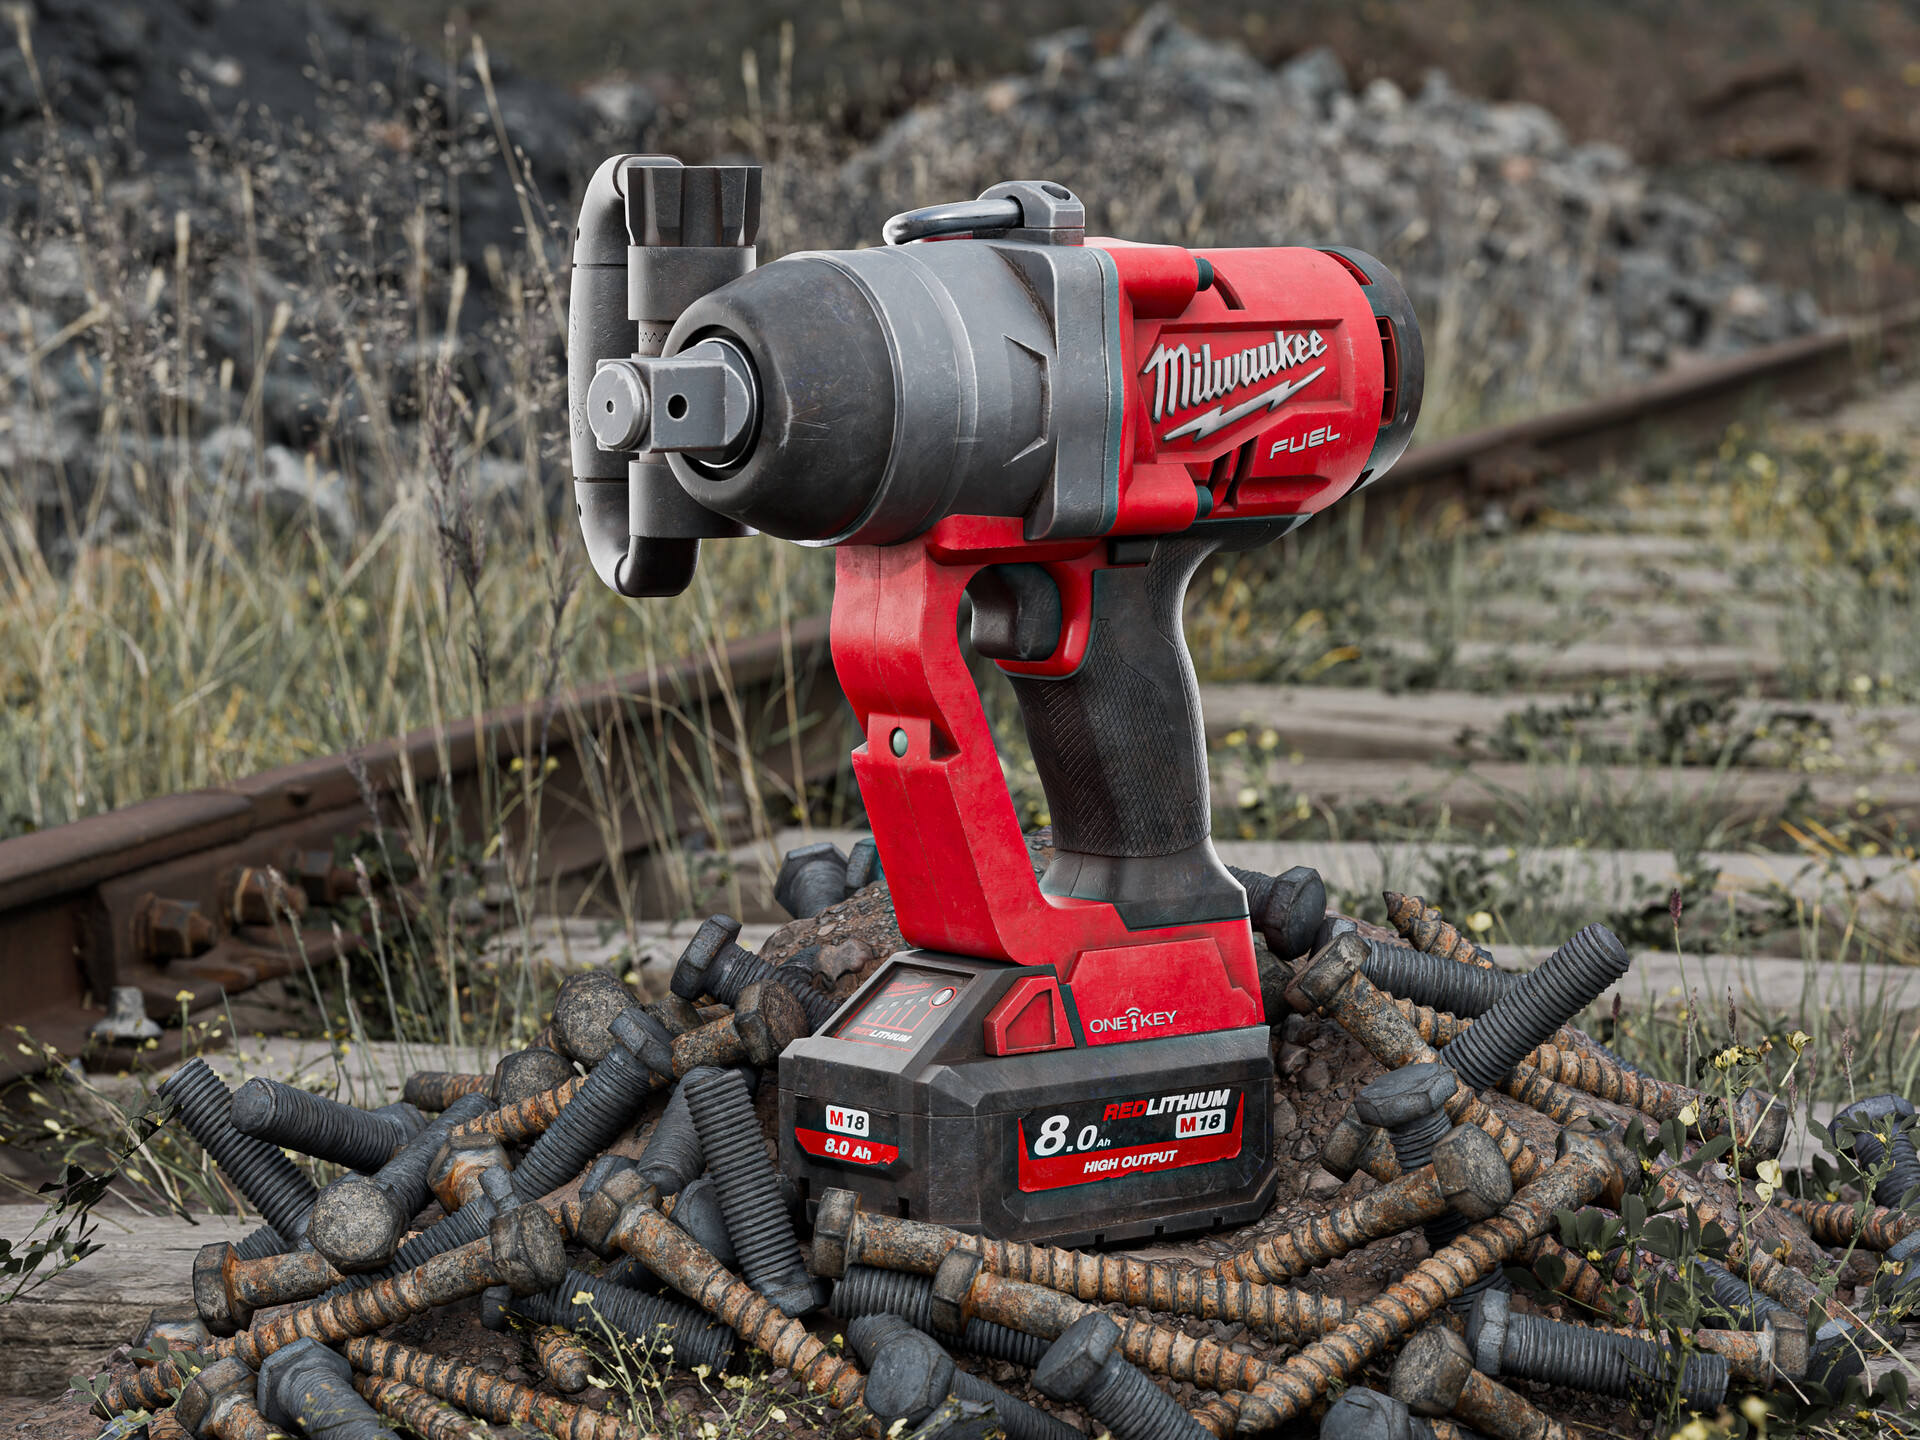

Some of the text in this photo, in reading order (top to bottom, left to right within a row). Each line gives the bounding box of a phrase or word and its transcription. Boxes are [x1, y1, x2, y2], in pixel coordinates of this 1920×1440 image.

[1143, 329, 1328, 424] Milwaukee
[1269, 425, 1341, 460] FUEL
[849, 1026, 912, 1043] REDLITHIUM
[1102, 1089, 1231, 1122] REDLITHIUM
[830, 1110, 866, 1132] M18
[1179, 1113, 1222, 1134] M18
[824, 1137, 873, 1161] 8.0 Ah
[1083, 1150, 1178, 1174] HIGH OUTPUT
